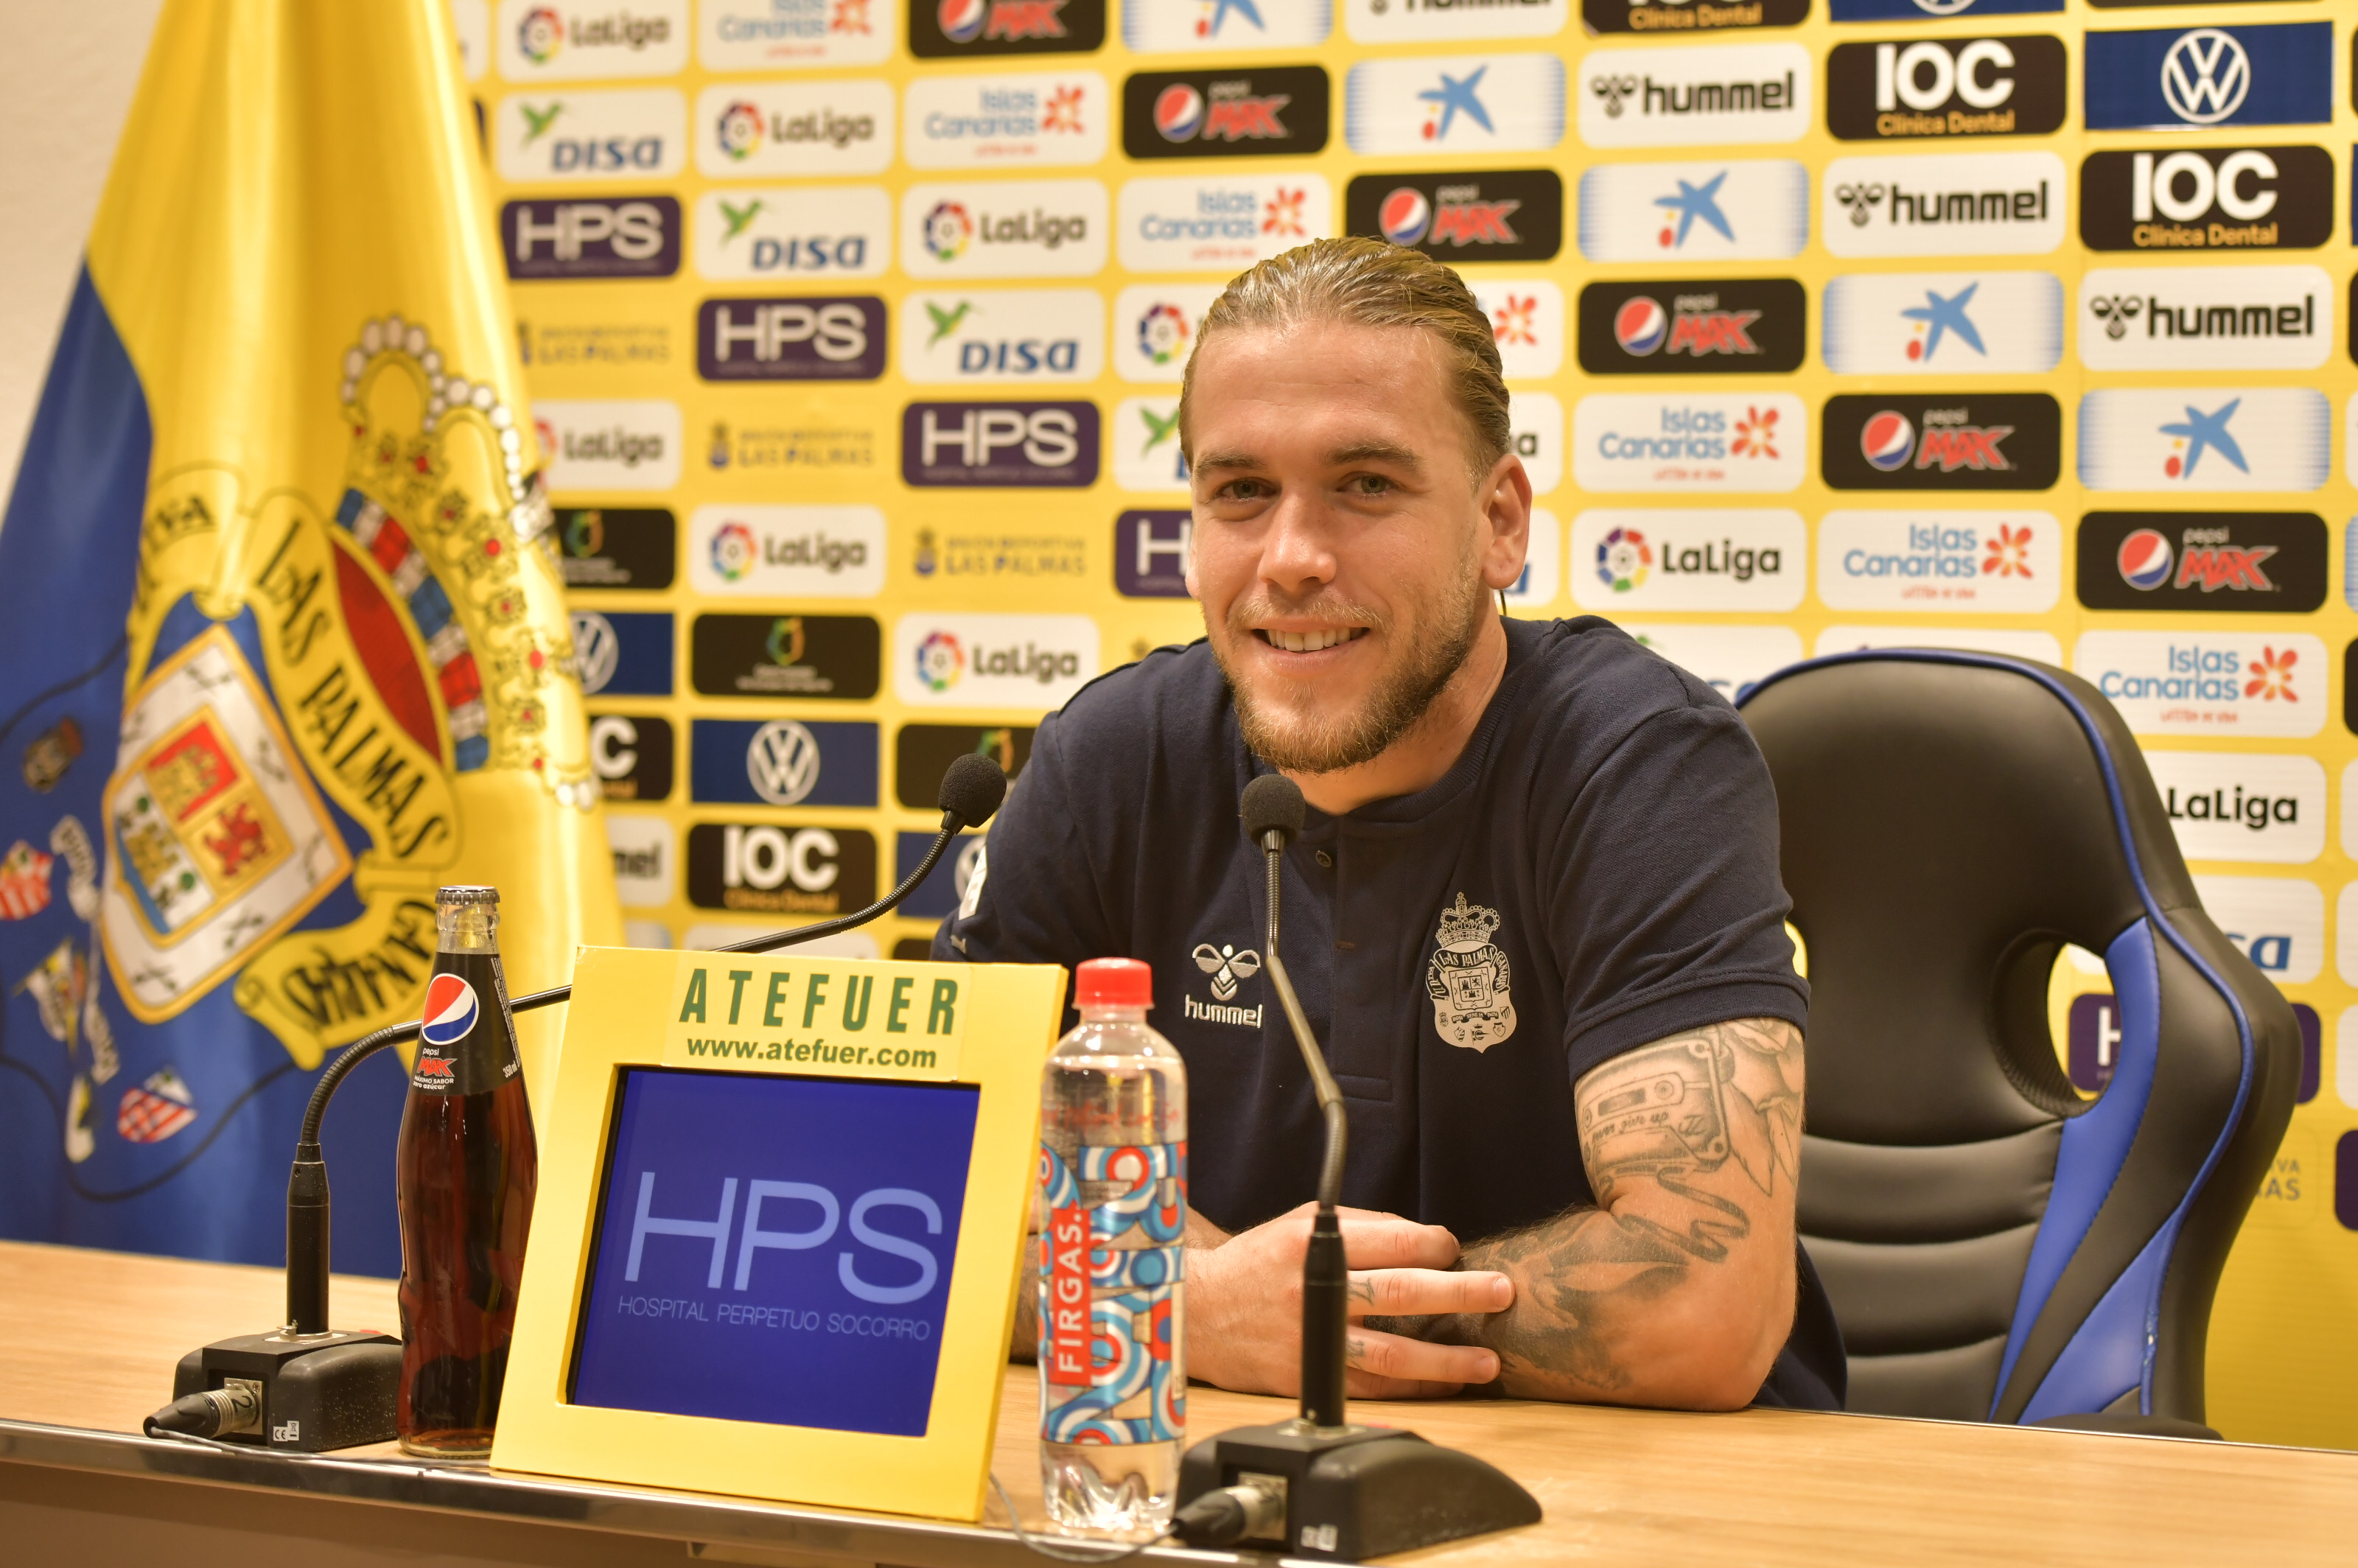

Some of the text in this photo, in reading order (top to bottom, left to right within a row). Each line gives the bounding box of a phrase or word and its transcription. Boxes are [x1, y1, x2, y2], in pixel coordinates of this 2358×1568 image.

[1642, 71, 1794, 116] hummel
[1876, 39, 2015, 111] IOC
[1949, 111, 2015, 134] Dental
[1890, 181, 2049, 224] hummel
[2133, 150, 2278, 222] IOC
[517, 201, 664, 262] HPS
[980, 207, 1086, 249] LaLiga
[2208, 222, 2278, 246] Dental
[714, 303, 867, 362] HPS
[1665, 310, 1763, 357] MAX
[2148, 295, 2315, 338] hummel
[920, 408, 1079, 467] HPS
[1661, 407, 1726, 433] Islas
[1598, 432, 1726, 460] Canarias
[1915, 425, 2015, 472] MAX
[1909, 524, 1977, 551] Islas
[1662, 539, 1782, 583] LaLiga
[1843, 549, 1977, 578] Canarias
[2174, 545, 2279, 592] MAX
[973, 643, 1079, 685] LaLiga
[2169, 645, 2239, 673] Islas
[2100, 670, 2239, 701] Canarias
[2168, 785, 2298, 831] LaLiga
[723, 825, 839, 892] IOC
[679, 968, 958, 1035] ATEFUER
[1184, 994, 1263, 1029] hummel
[416, 1057, 458, 1078] MAX
[422, 1047, 439, 1057] pepsi
[687, 1037, 937, 1068] www.atefuer.com
[624, 1172, 943, 1305] HPS
[618, 1295, 931, 1342] HOSPITAL PERPETUO SOCORRO
